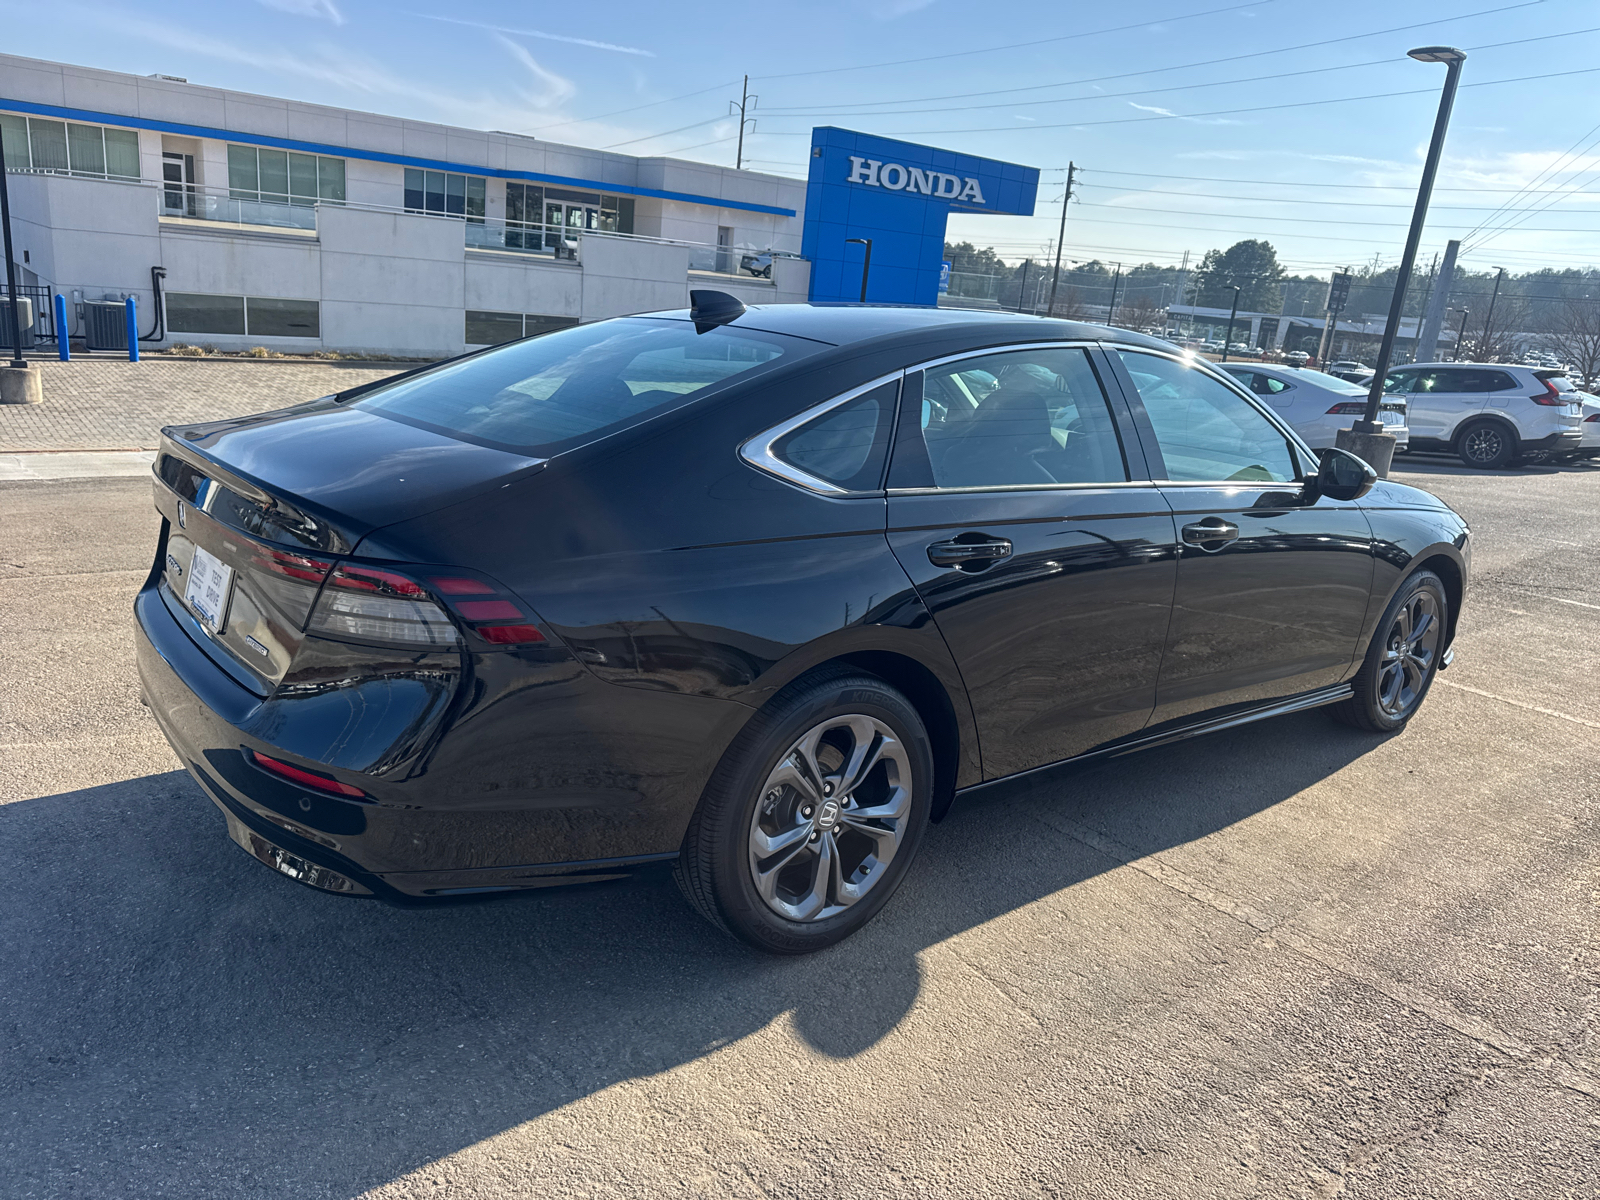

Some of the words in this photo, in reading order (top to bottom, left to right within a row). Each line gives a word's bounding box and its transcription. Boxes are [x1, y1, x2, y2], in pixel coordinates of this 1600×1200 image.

[847, 156, 986, 203] HONDA
[211, 569, 222, 588] TEST
[206, 585, 220, 607] DRIVE
[852, 691, 903, 711] KINERGY
